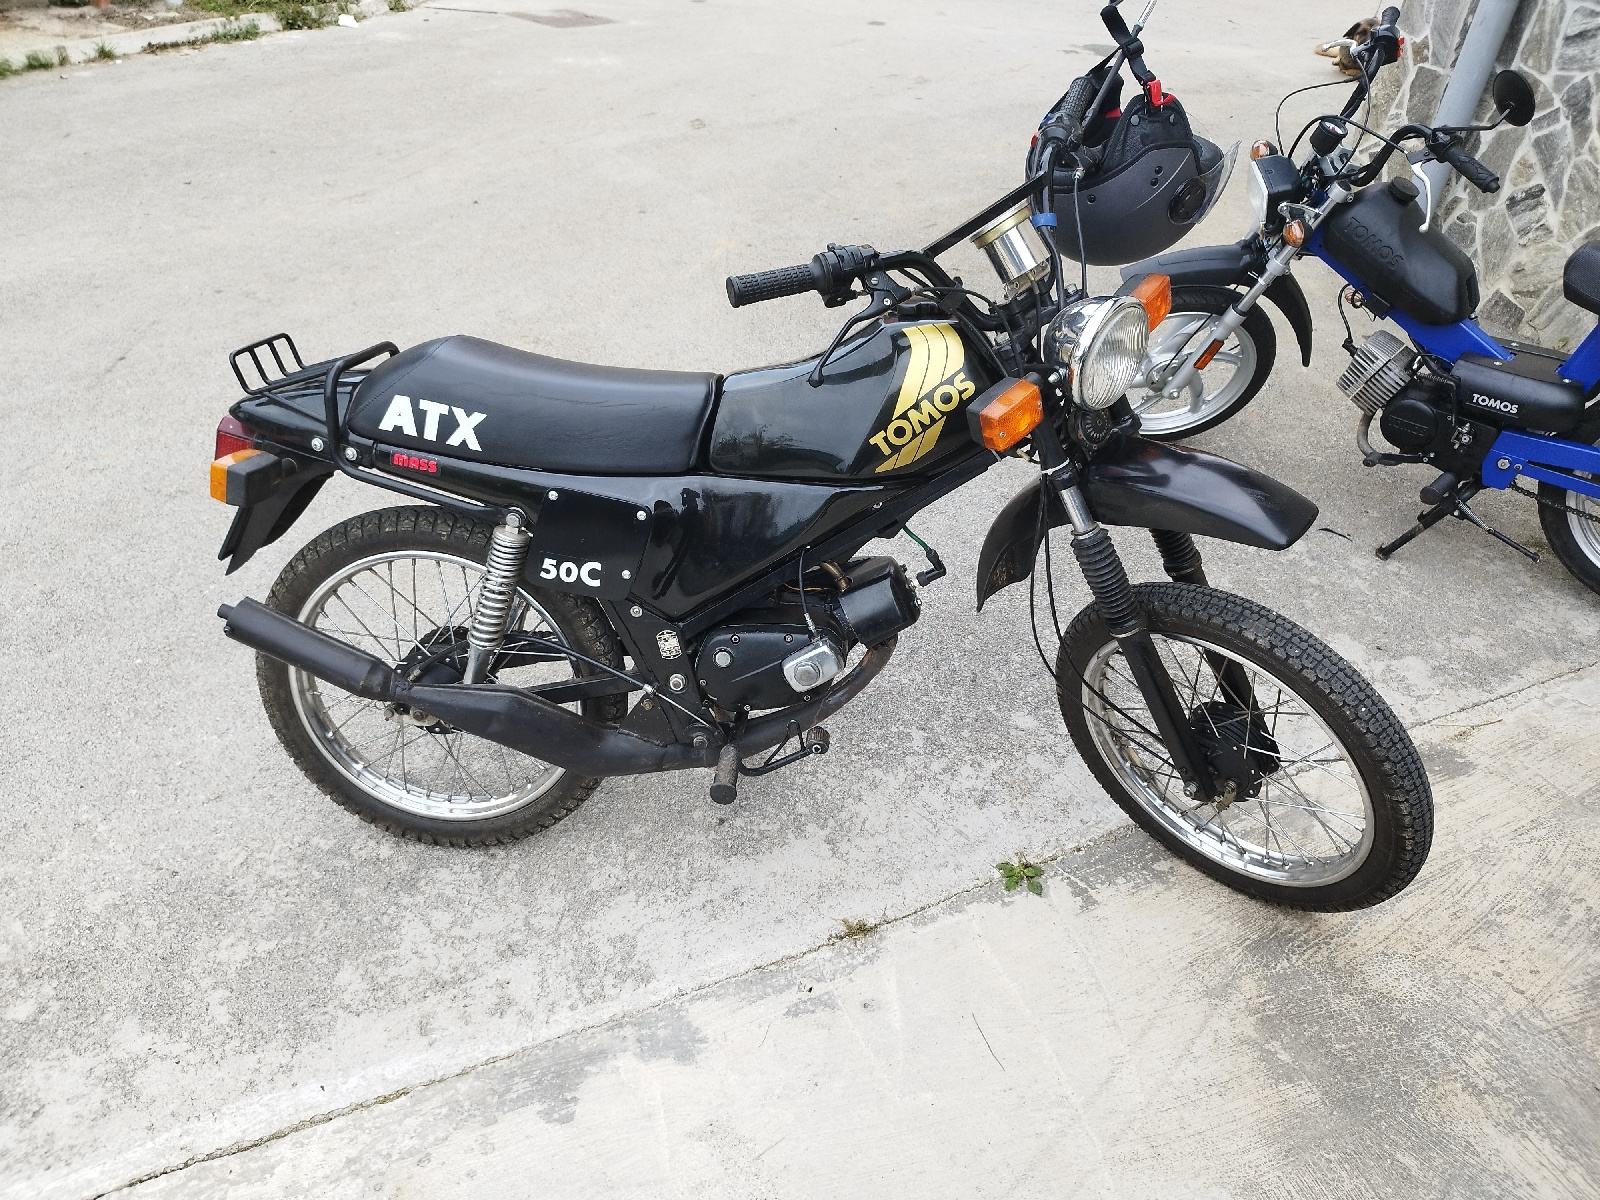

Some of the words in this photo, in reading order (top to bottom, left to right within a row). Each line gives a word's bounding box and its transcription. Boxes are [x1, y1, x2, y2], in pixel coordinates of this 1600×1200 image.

[1345, 216, 1405, 269] TOMOS
[378, 394, 488, 452] ATX
[868, 371, 976, 457] TOMOS
[1472, 393, 1519, 414] TOMOS
[539, 558, 602, 587] 50C
